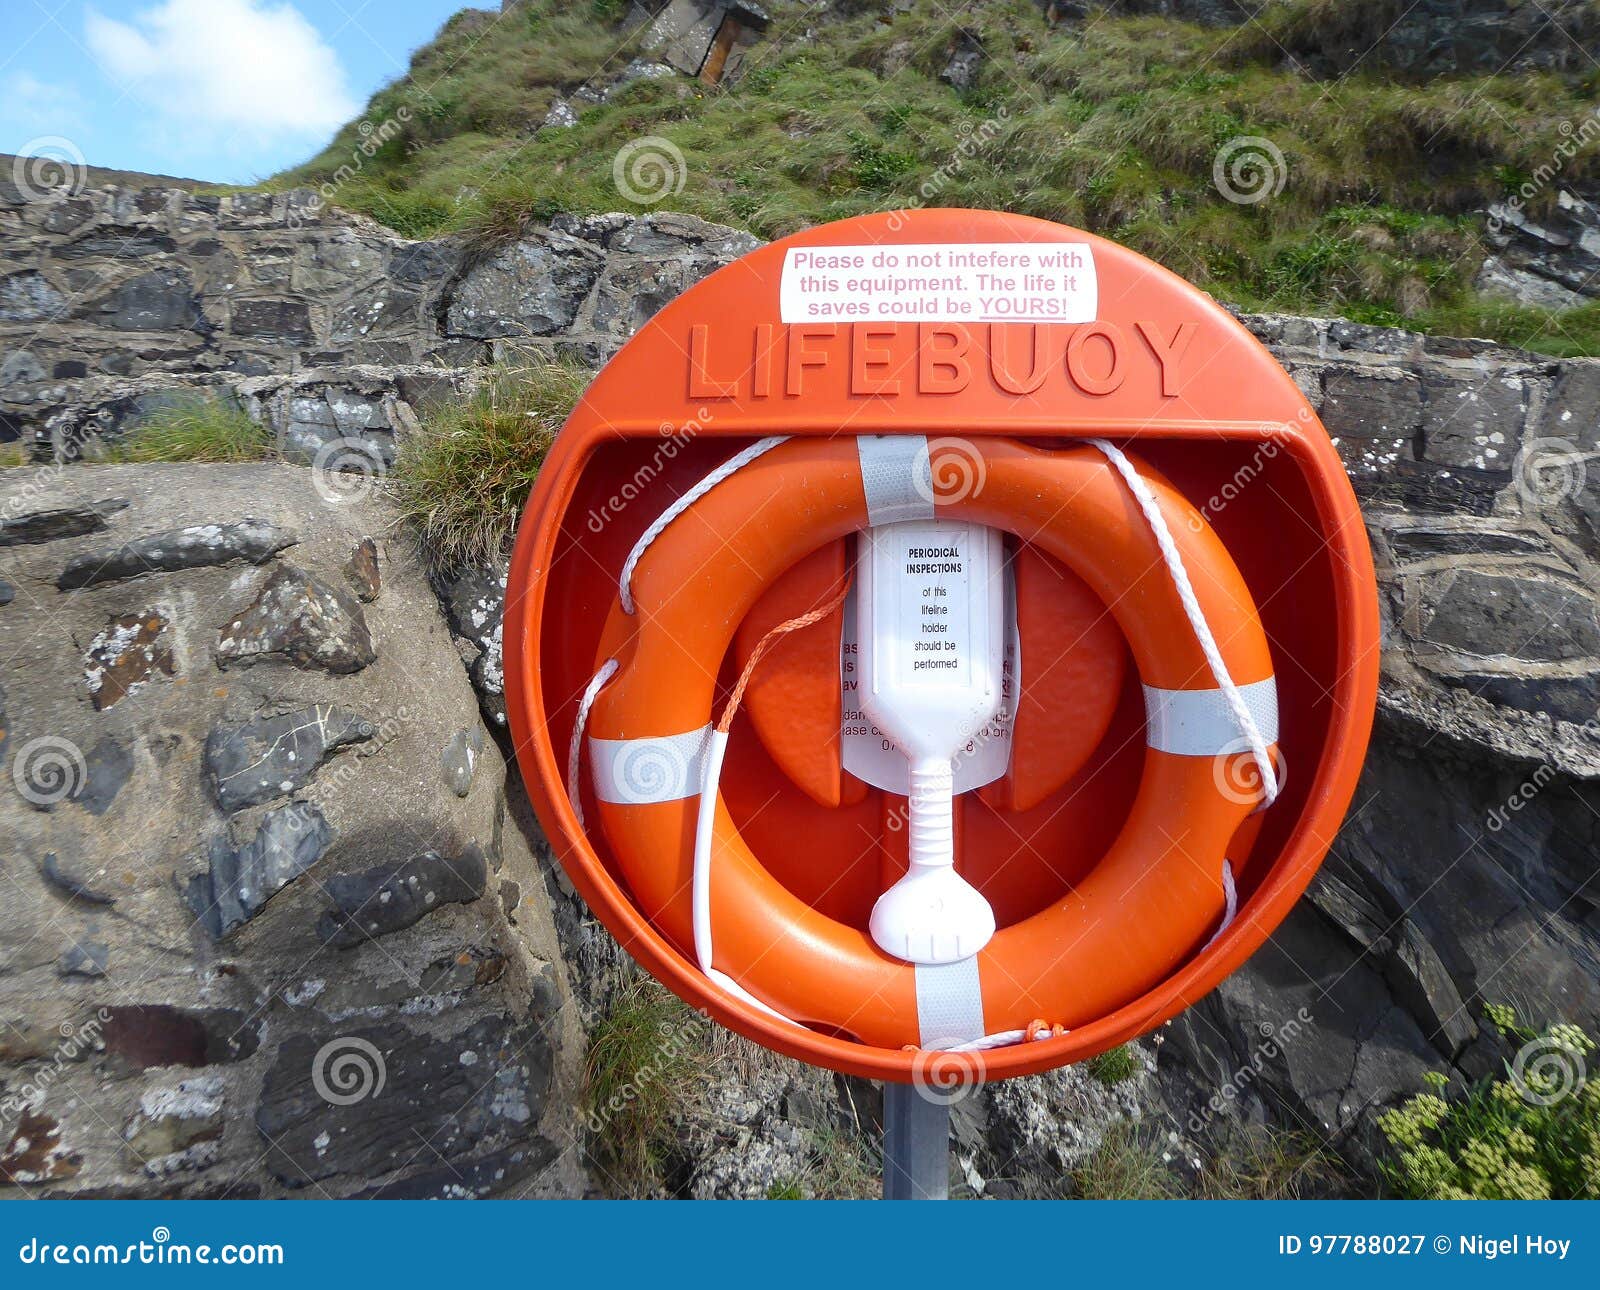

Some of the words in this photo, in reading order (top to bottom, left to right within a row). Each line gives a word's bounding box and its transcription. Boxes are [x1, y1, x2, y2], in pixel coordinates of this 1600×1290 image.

[794, 252, 865, 269] Please
[872, 251, 899, 268] do
[906, 251, 942, 268] not
[949, 251, 1031, 268] intefere
[1038, 251, 1083, 268] with
[800, 275, 840, 292] this
[846, 274, 968, 295] equipment.
[976, 274, 1016, 291] The
[1024, 274, 1056, 291] life
[1064, 275, 1077, 291] it
[808, 301, 871, 315] saves
[878, 298, 938, 314] could
[946, 298, 972, 314] be
[979, 297, 1067, 320] YOURS!
[688, 321, 1197, 400] LIFEBUOY
[908, 547, 960, 558] PERIODICAL
[906, 562, 962, 574] INSPECTIONS
[922, 586, 931, 597] of
[934, 586, 947, 597] this
[921, 604, 948, 615] lifeline
[921, 622, 948, 633] holder
[914, 640, 942, 651] should
[944, 640, 956, 651] be
[914, 658, 958, 670] performed
